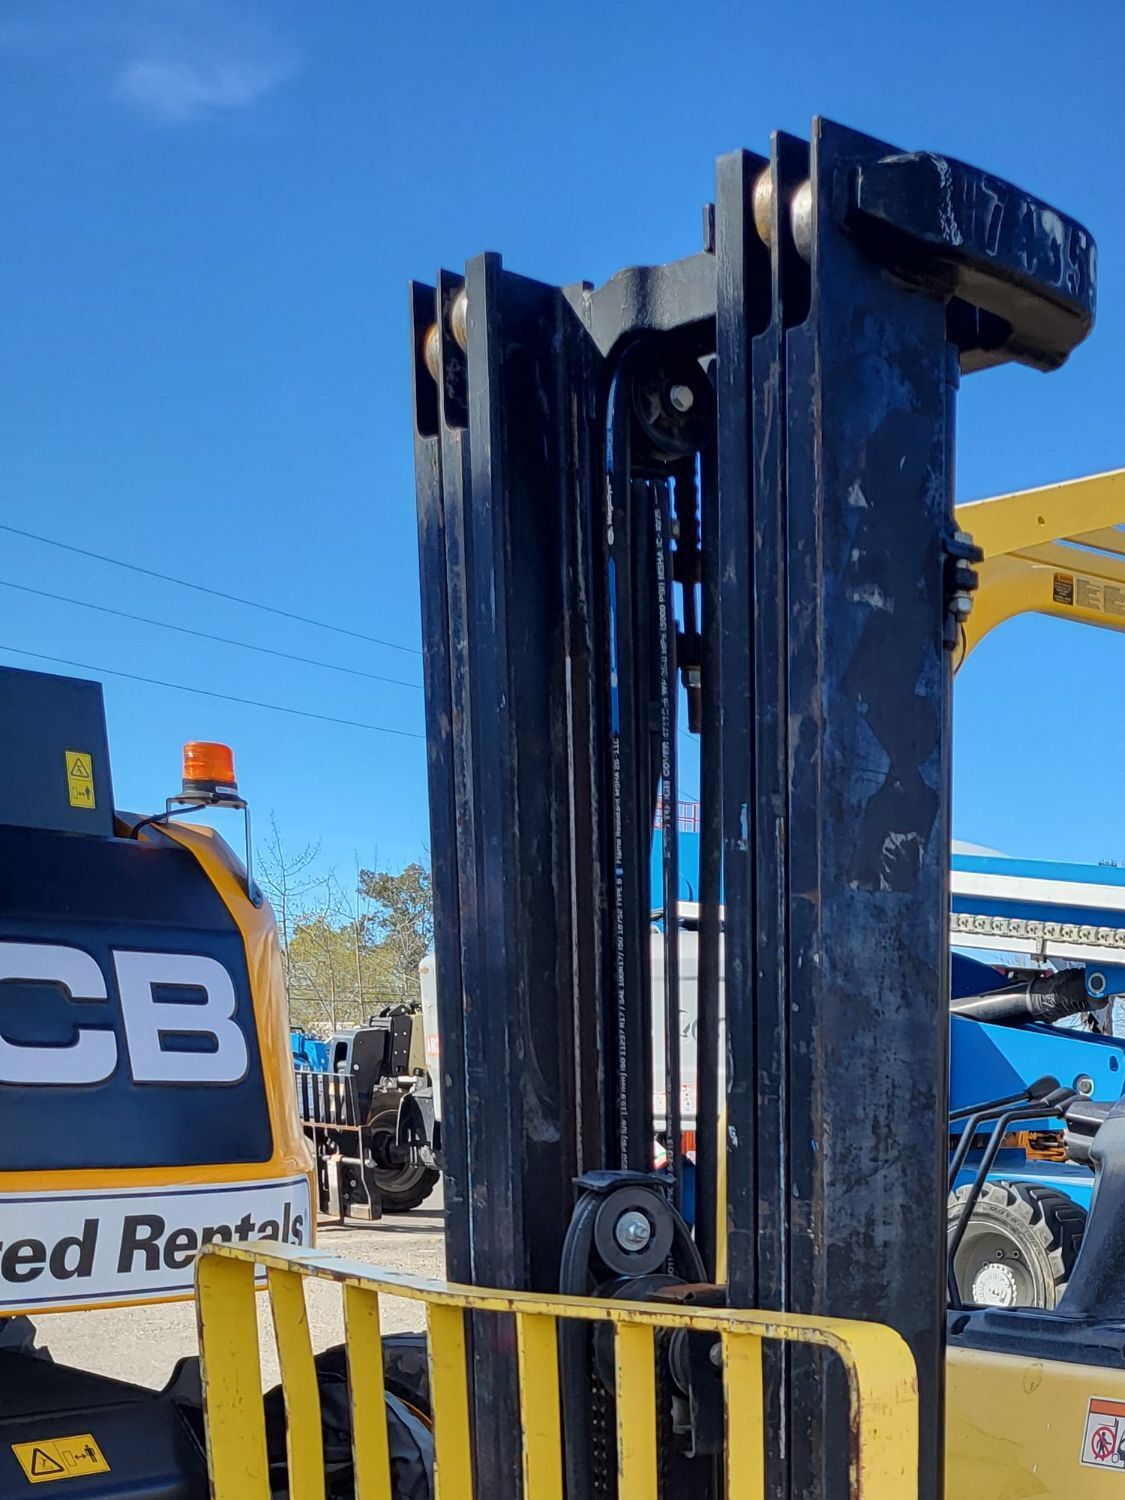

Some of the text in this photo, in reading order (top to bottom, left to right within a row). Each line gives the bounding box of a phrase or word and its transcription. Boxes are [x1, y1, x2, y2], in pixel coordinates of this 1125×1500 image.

[613, 772, 621, 797] MSHA
[614, 798, 622, 837] Resistant
[615, 839, 623, 865] Flame
[618, 1030, 626, 1056] 11237
[0, 1217, 100, 1284] ed
